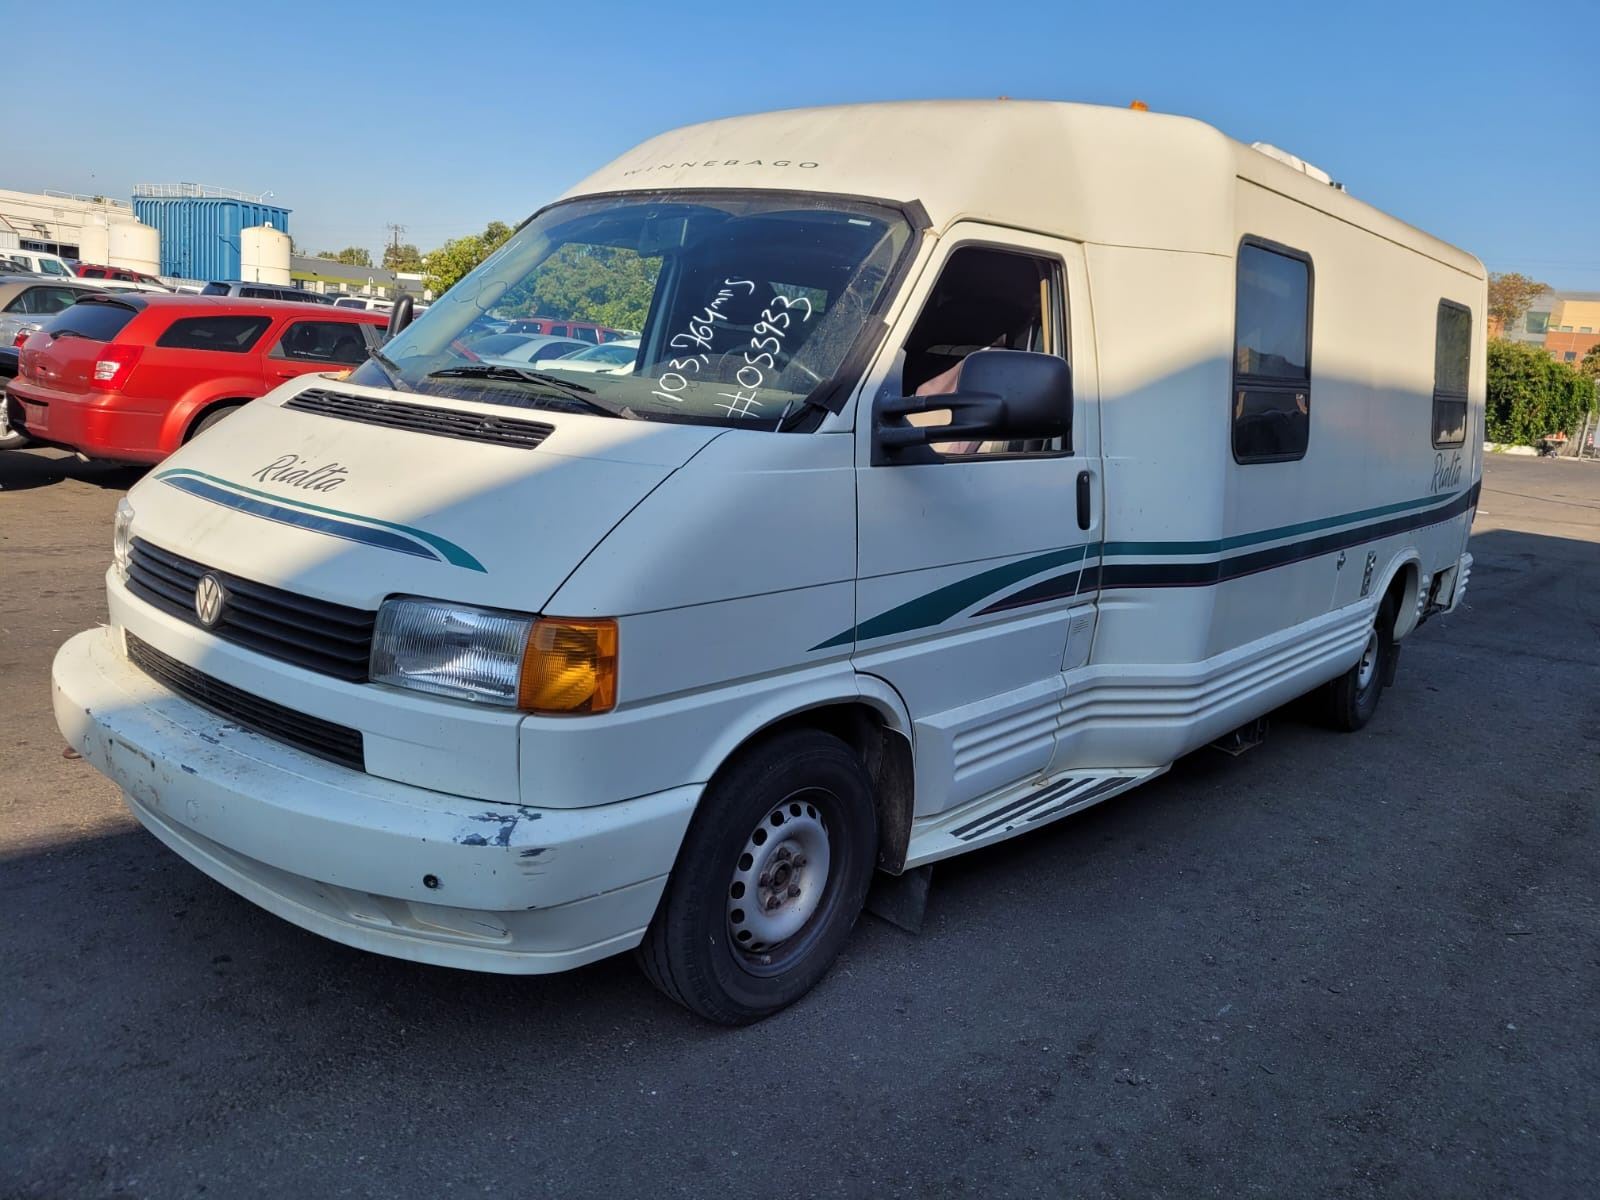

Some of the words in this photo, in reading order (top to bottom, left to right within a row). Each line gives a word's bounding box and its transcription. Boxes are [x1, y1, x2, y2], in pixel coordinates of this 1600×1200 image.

[623, 160, 819, 176] WINNEBAGO
[713, 295, 812, 419] #053933
[252, 454, 349, 493] Rialta
[1431, 452, 1462, 494] Rialta
